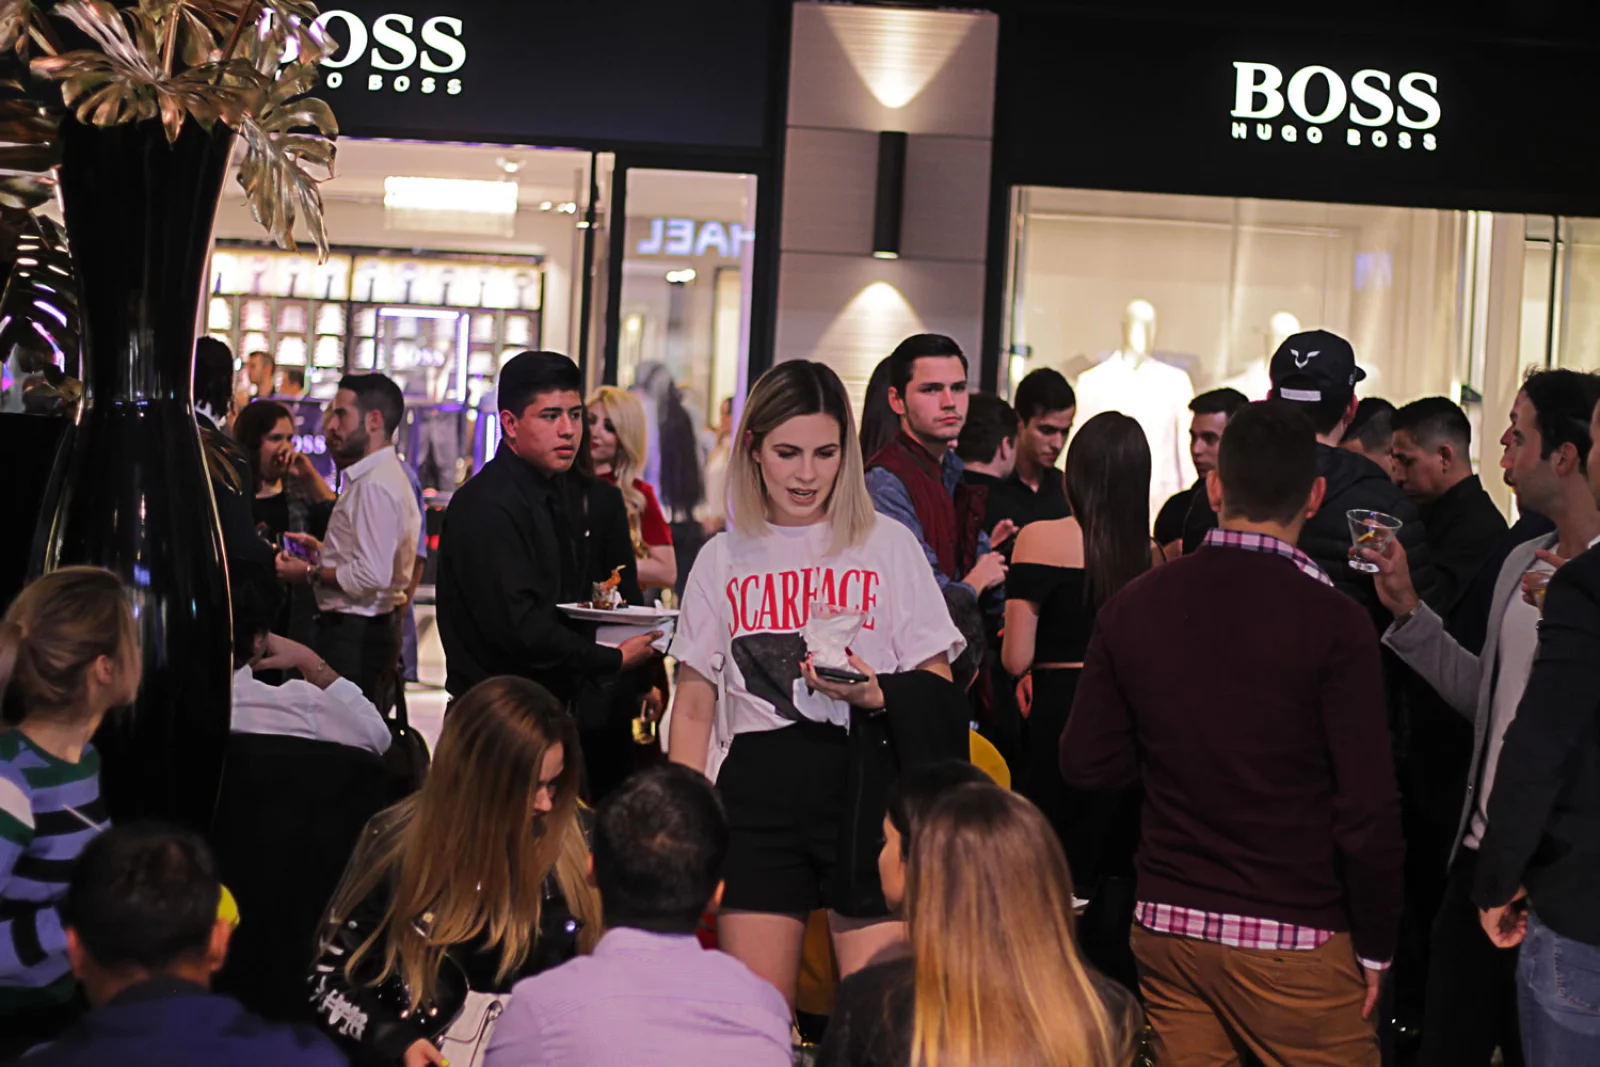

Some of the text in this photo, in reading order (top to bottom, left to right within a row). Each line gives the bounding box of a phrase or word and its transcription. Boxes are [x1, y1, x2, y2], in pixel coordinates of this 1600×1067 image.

[367, 73, 463, 95] BOSS
[1230, 61, 1442, 130] BOSS
[1231, 121, 1438, 151] HUGO BOSS
[291, 434, 327, 455] OSS
[725, 566, 880, 639] SCARFACE
